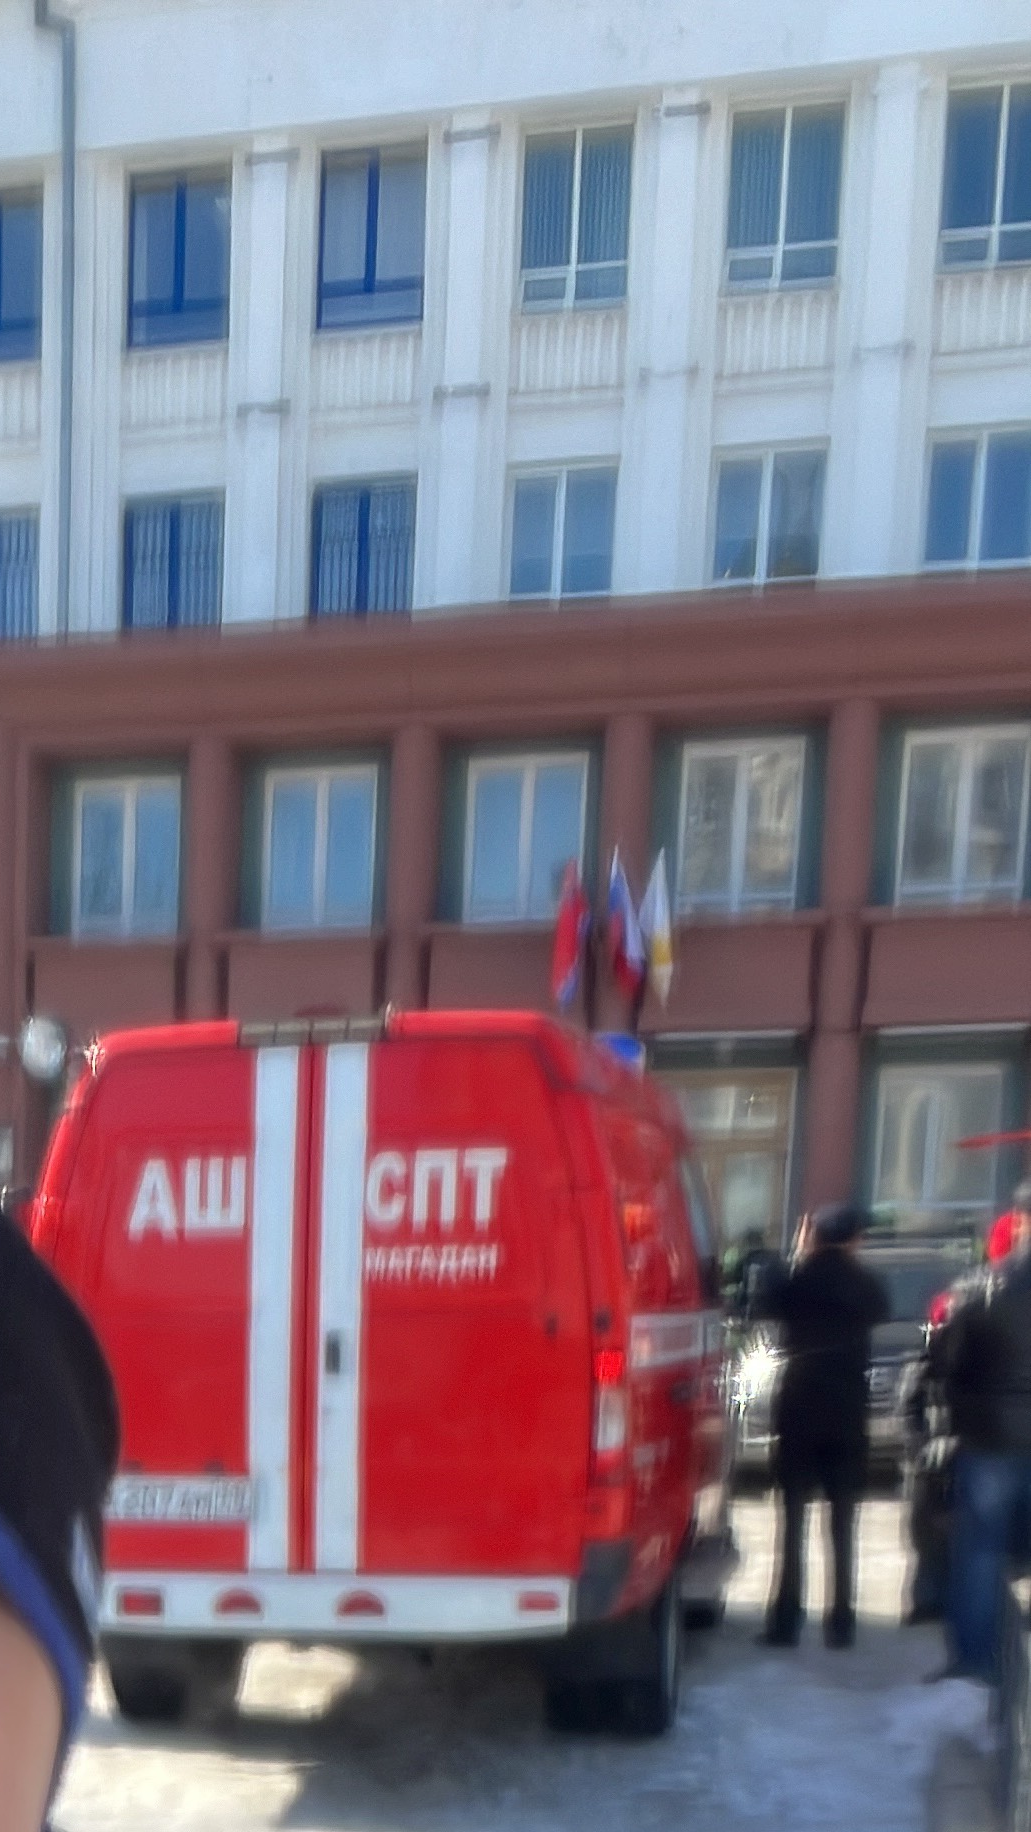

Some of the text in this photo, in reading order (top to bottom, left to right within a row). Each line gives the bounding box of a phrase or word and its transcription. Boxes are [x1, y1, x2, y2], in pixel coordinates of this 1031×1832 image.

[128, 1147, 507, 1242] АШ СПТ
[365, 1244, 499, 1286] МАГАДАН
